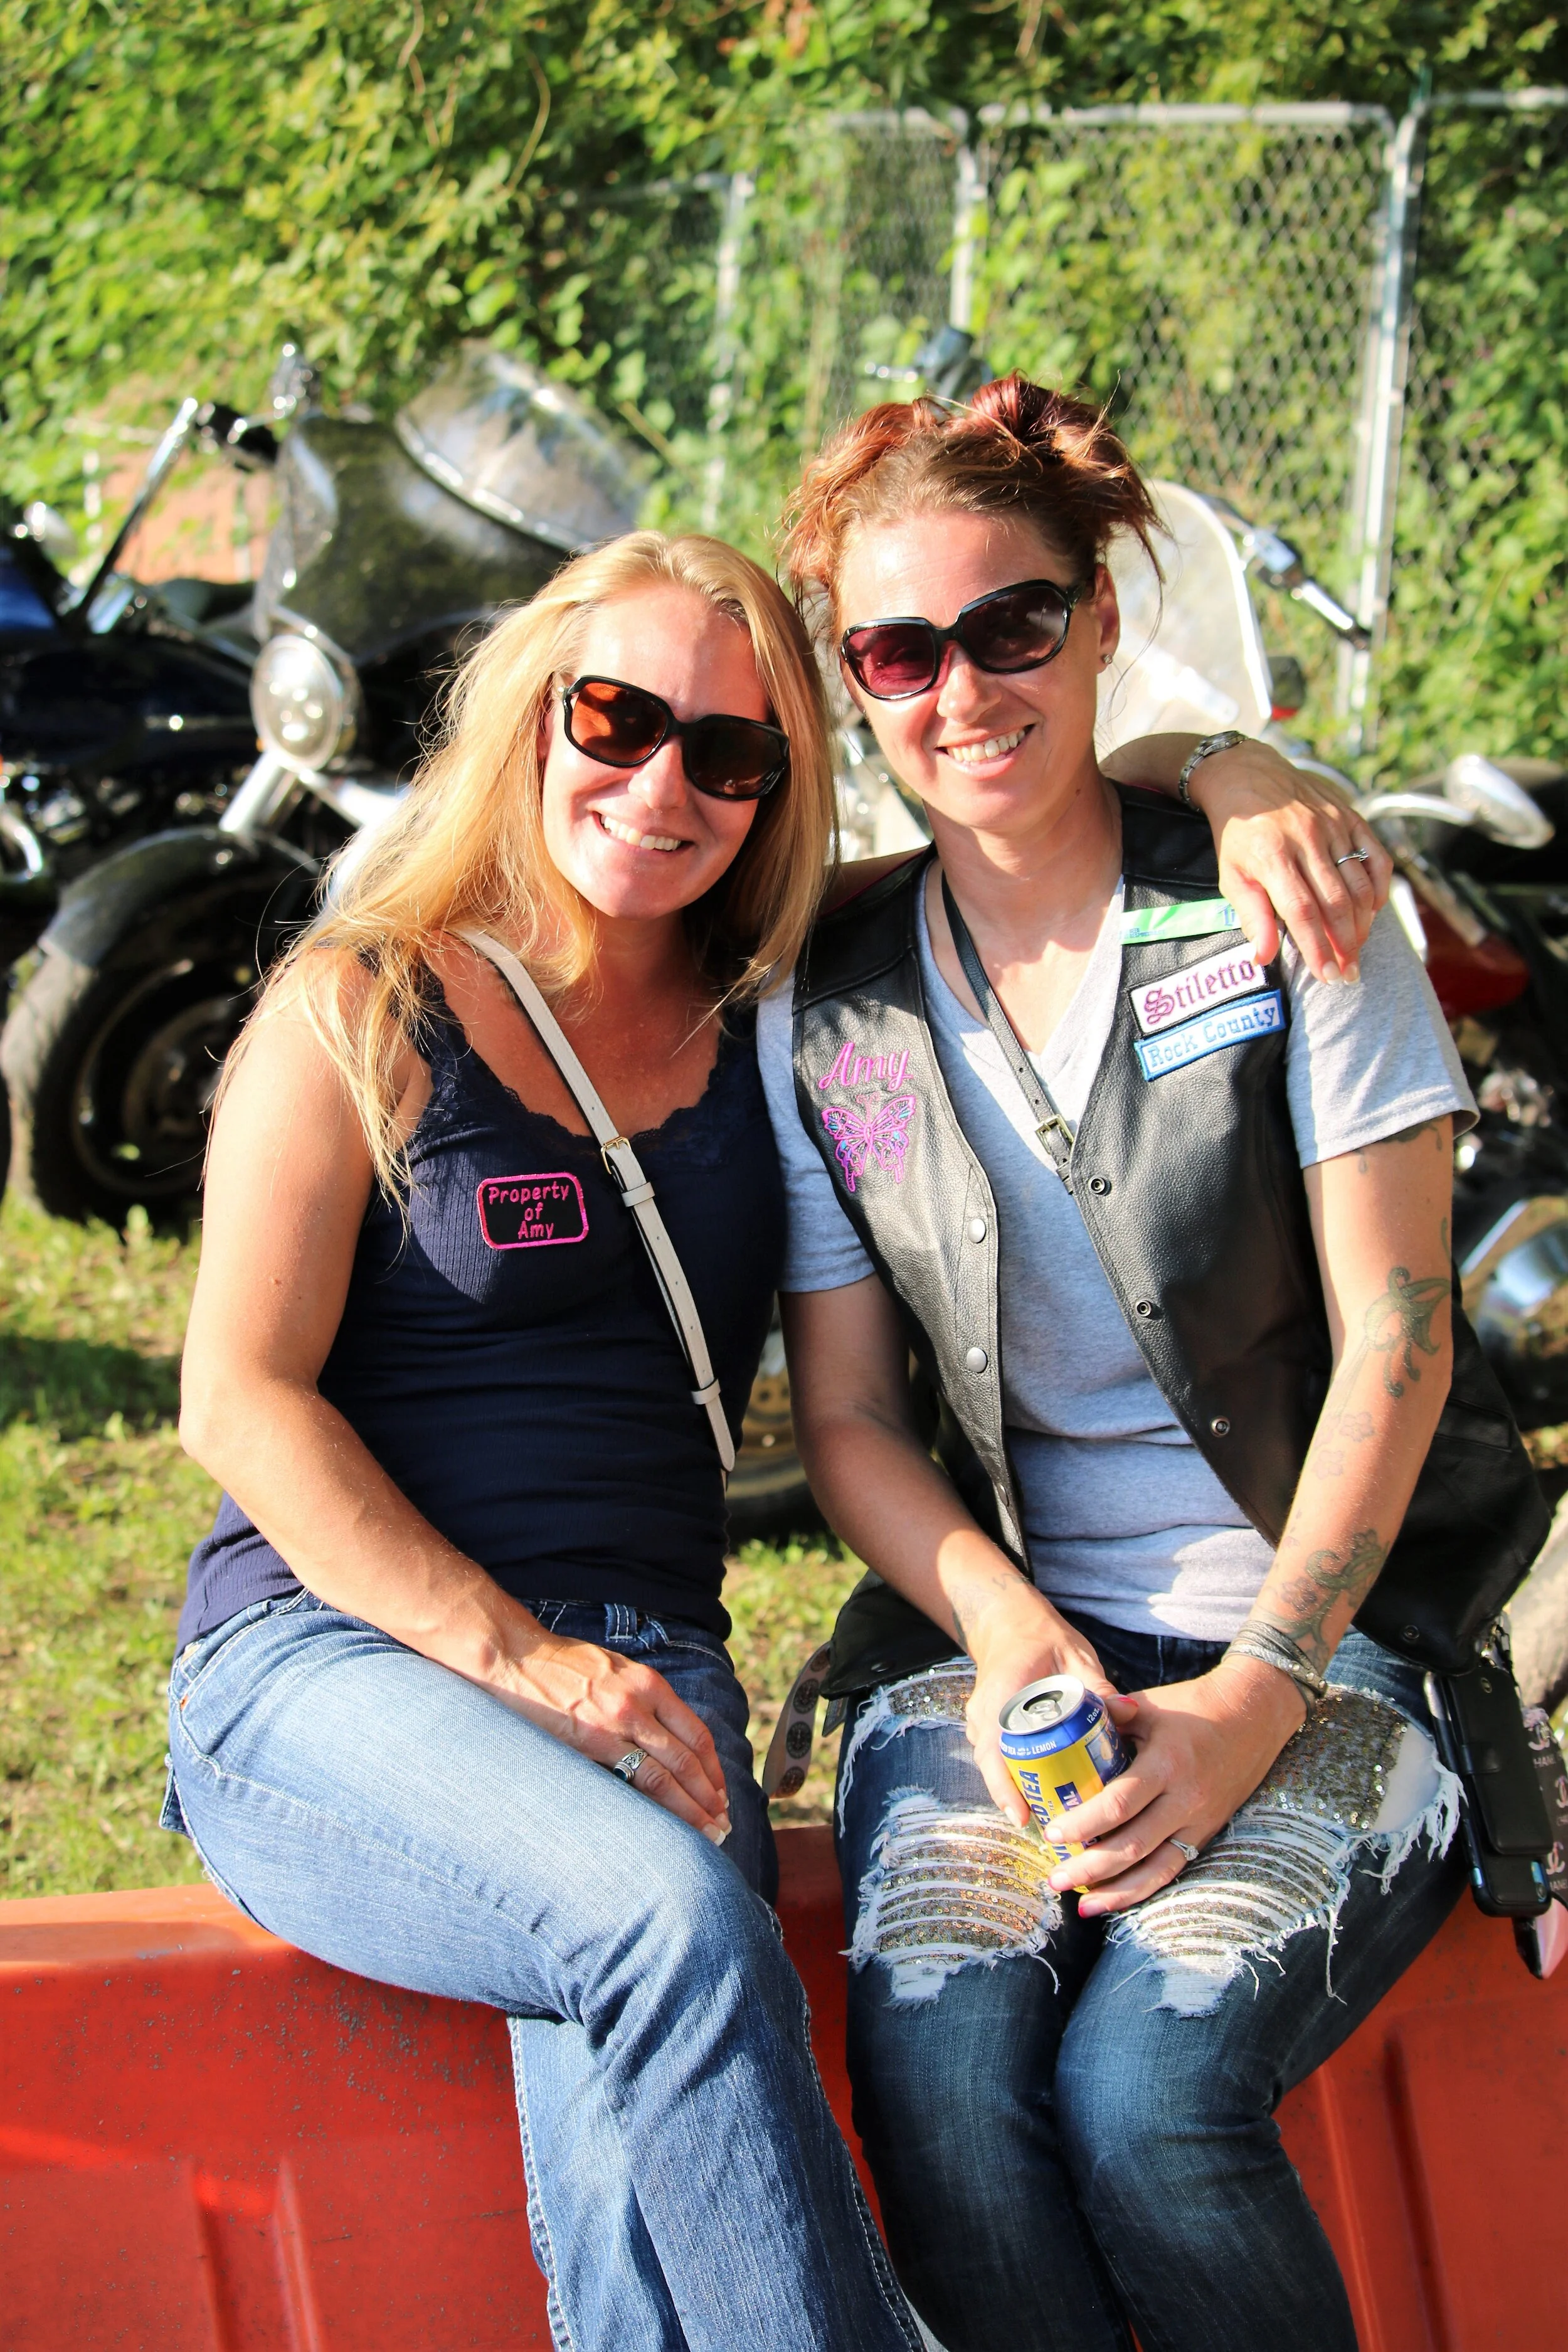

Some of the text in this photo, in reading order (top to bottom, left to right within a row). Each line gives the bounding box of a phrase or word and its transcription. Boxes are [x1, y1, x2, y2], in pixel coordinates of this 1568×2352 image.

[1143, 960, 1256, 1025] Stiletto
[1147, 1005, 1276, 1068] Rock County
[818, 1041, 913, 1091] Amy
[488, 1181, 569, 1205] Property
[524, 1202, 543, 1221] of
[518, 1221, 554, 1239] Amy
[1032, 1740, 1057, 1755] LEMON
[1019, 1770, 1044, 1803] TEA
